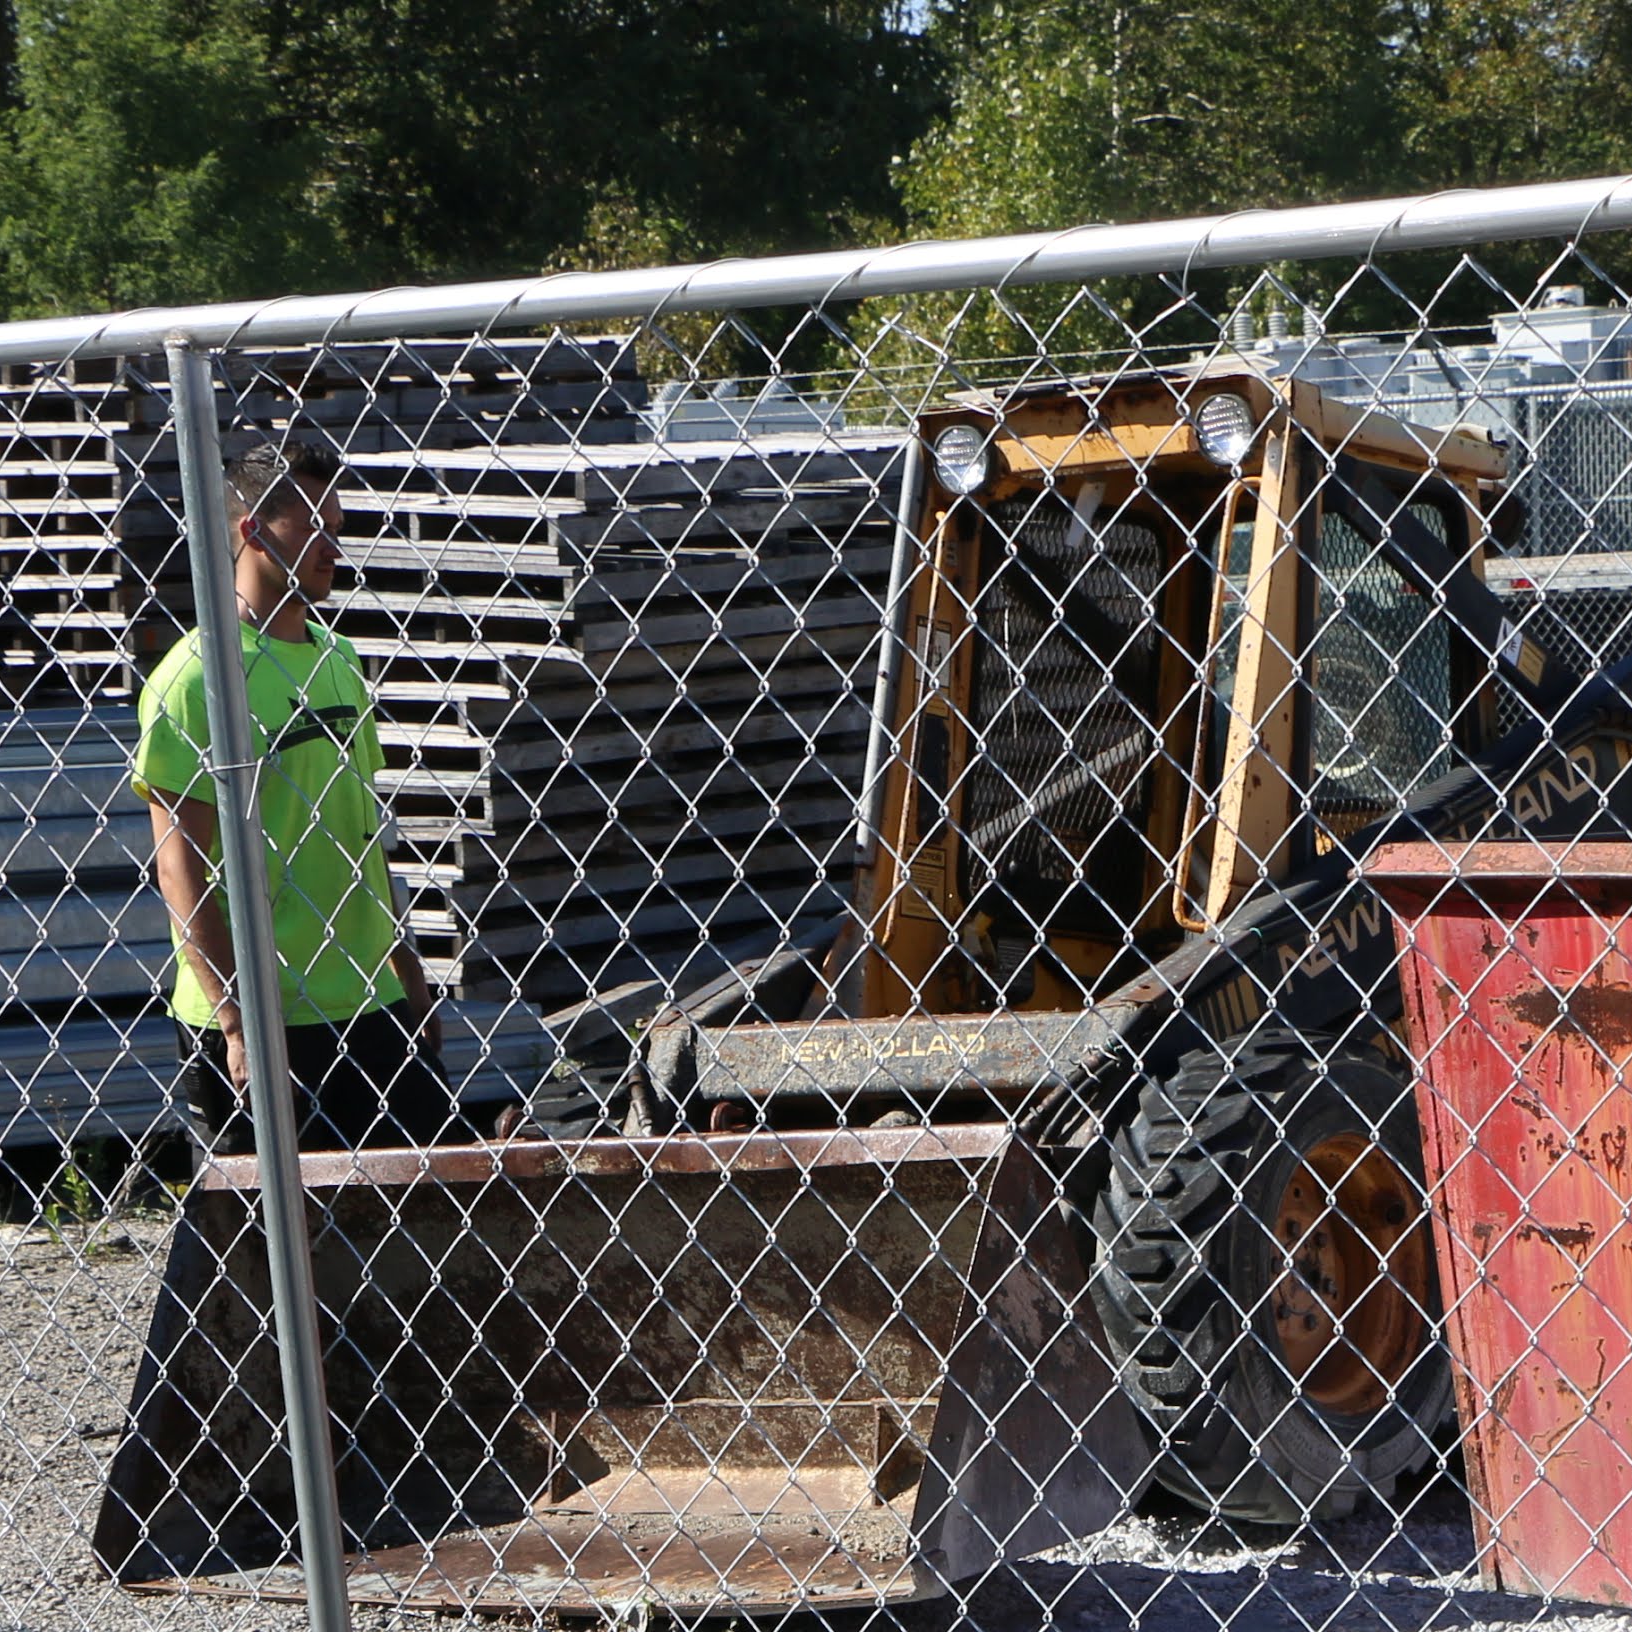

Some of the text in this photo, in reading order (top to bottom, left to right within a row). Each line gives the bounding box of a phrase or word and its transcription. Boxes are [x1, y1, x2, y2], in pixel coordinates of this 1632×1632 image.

[1277, 896, 1381, 996] NEW
[781, 1033, 986, 1063] NEW HOLLAND
